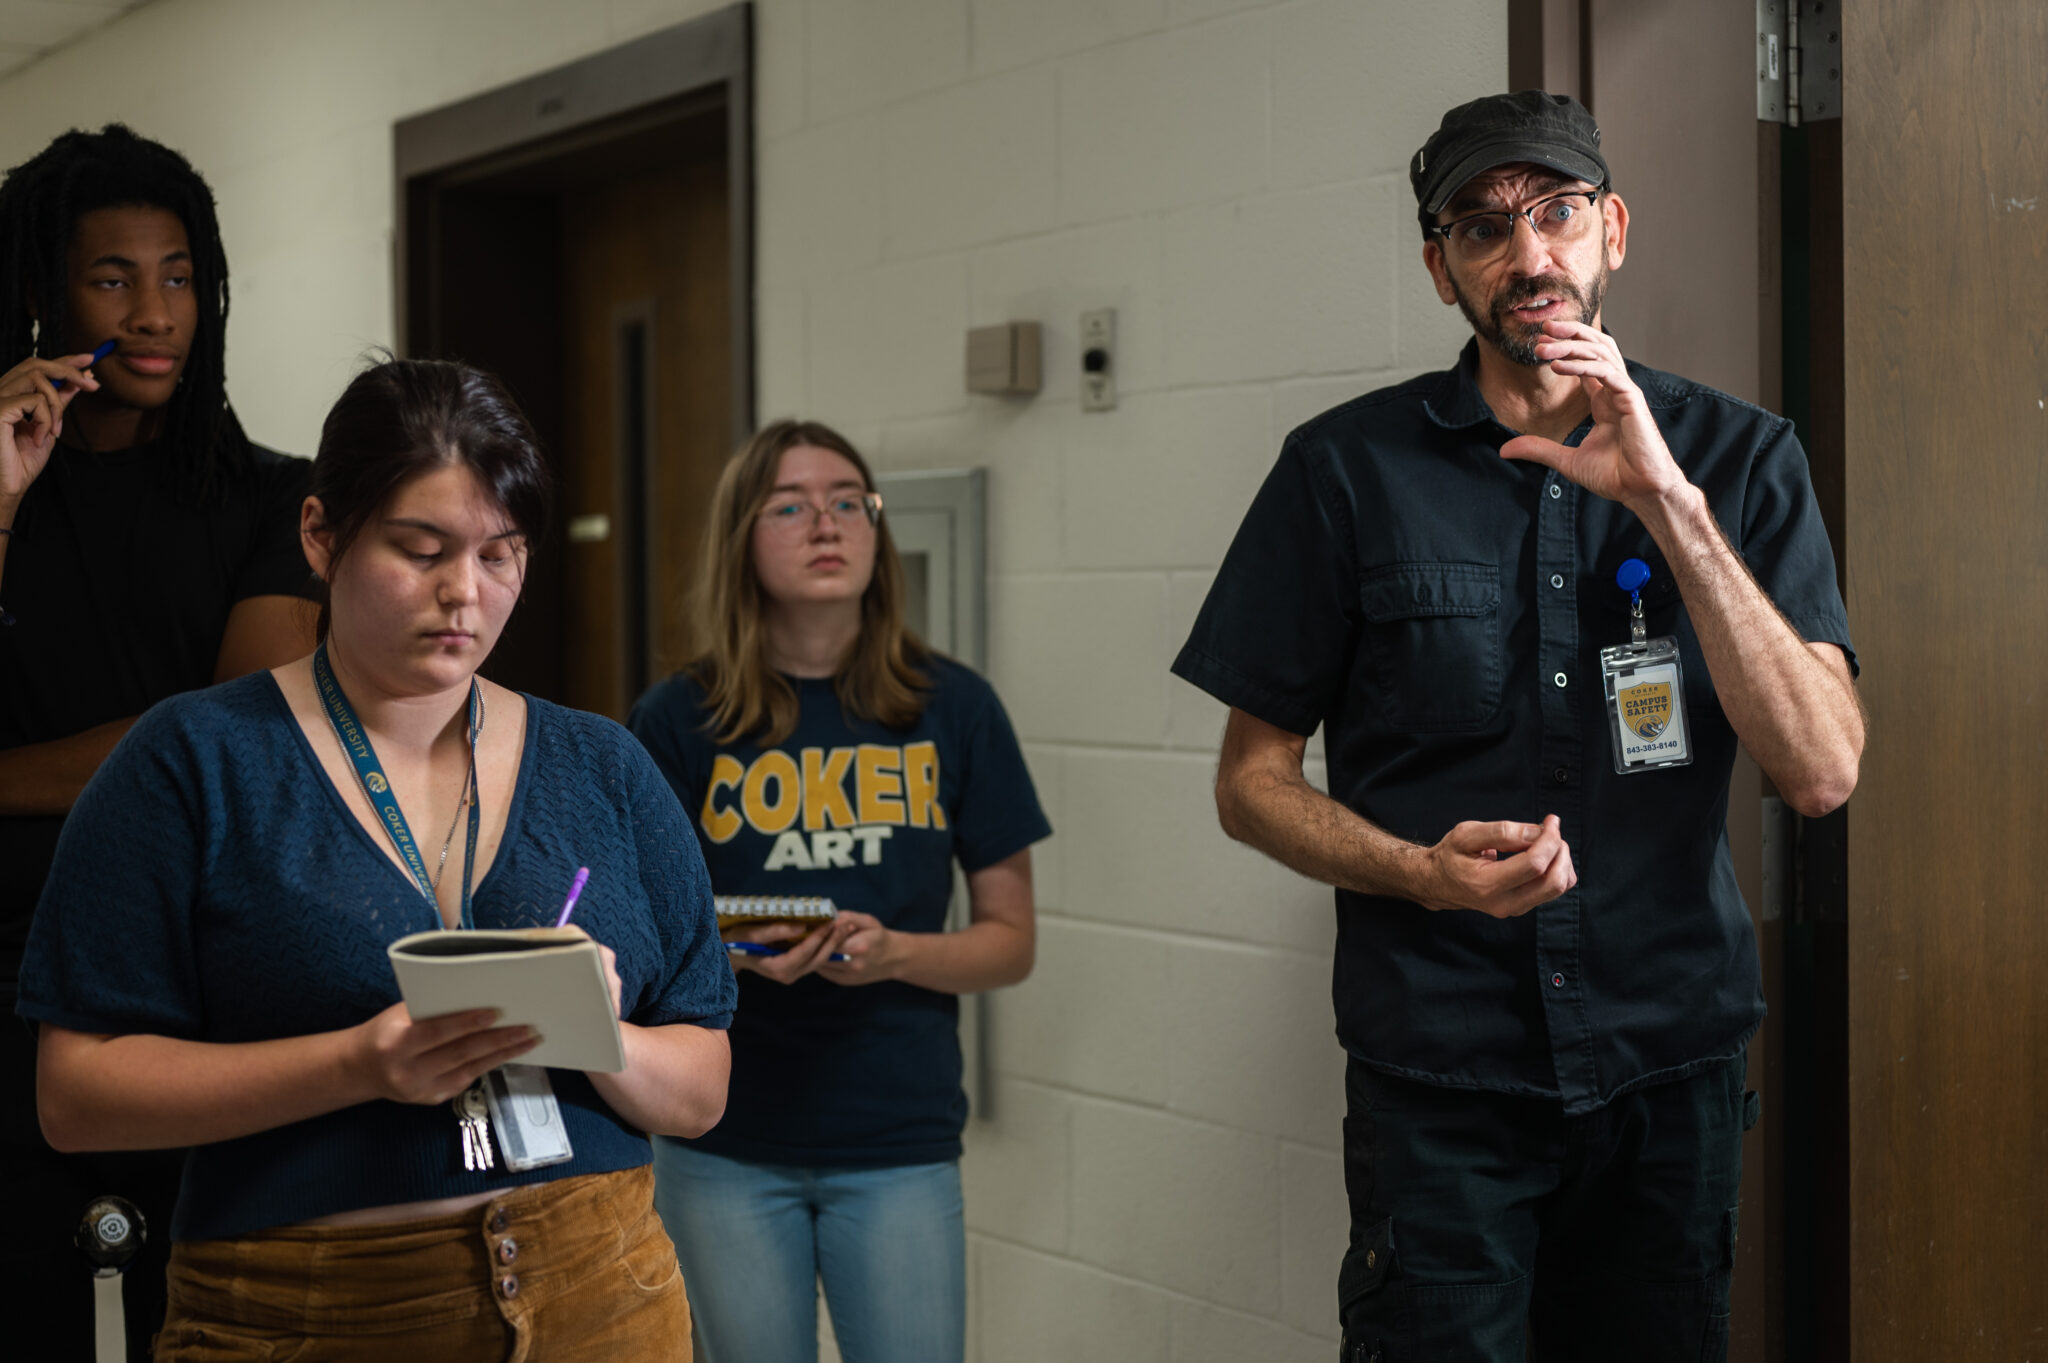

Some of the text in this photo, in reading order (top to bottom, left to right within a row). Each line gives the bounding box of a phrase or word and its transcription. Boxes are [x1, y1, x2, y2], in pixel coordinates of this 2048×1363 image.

[1625, 695, 1668, 709] CAMPUS
[1627, 703, 1668, 717] SAFETY
[329, 693, 369, 758] UNIVERSITY
[1626, 740, 1678, 755] 843-383-8140
[700, 740, 947, 844] COKER
[384, 805, 409, 843] COKER
[763, 825, 893, 871] ART
